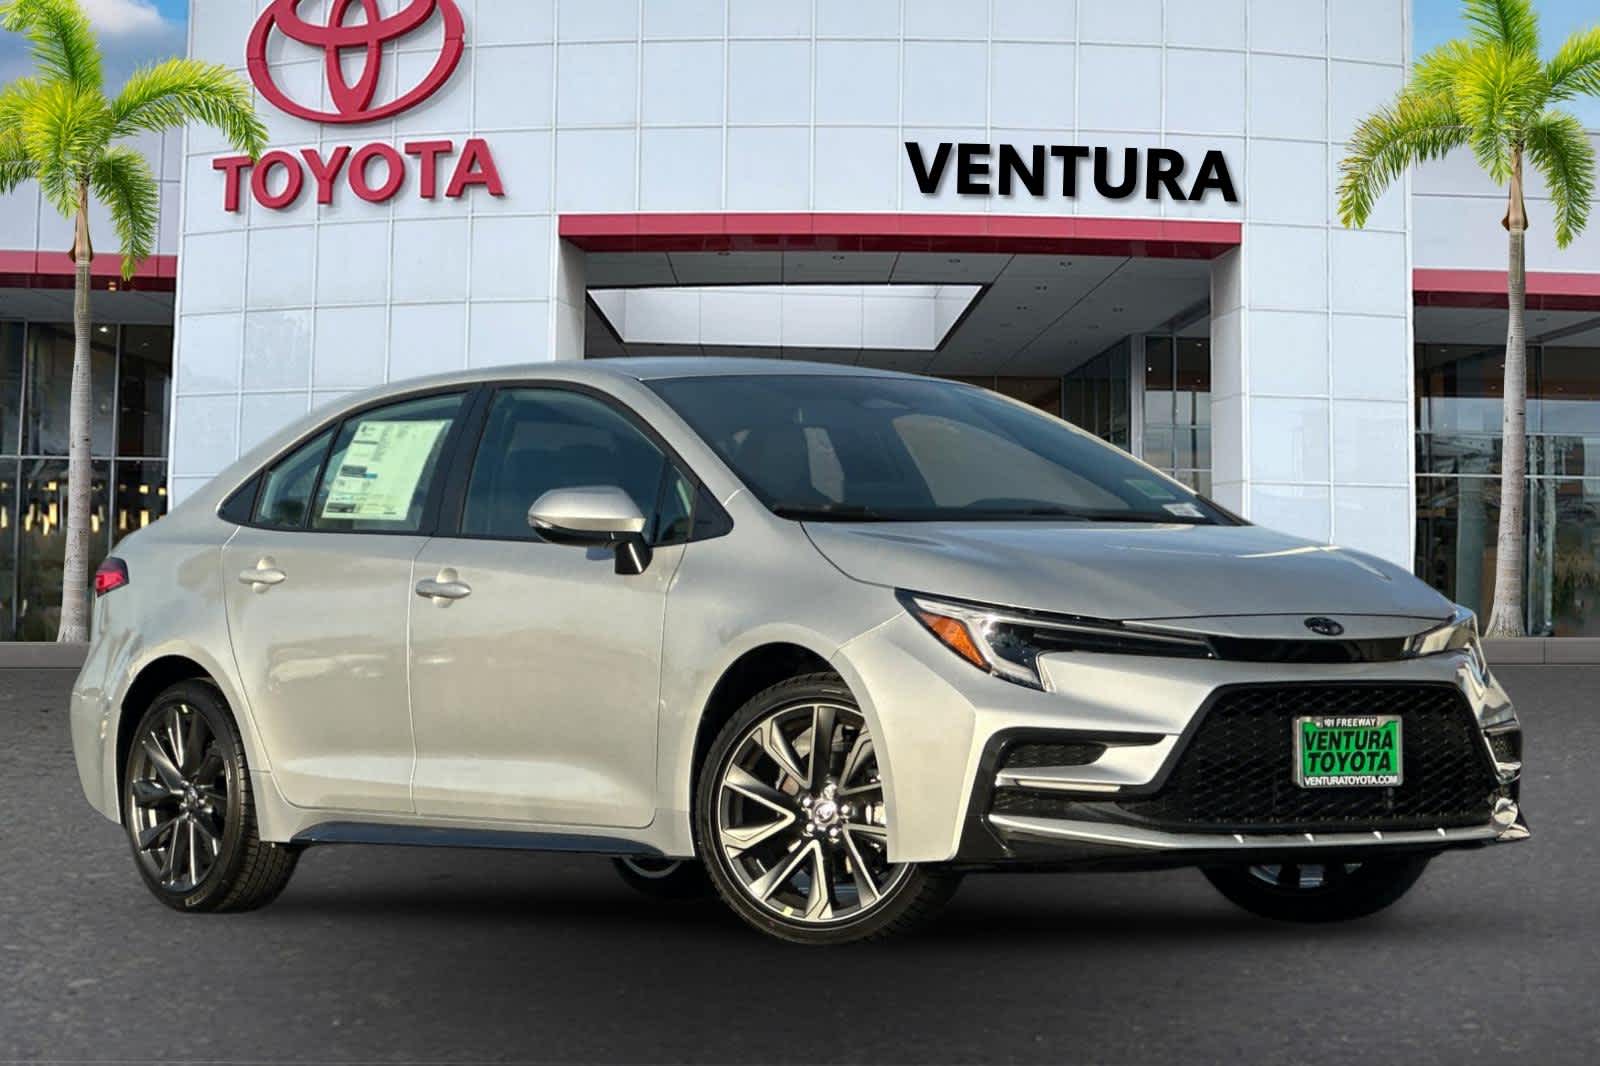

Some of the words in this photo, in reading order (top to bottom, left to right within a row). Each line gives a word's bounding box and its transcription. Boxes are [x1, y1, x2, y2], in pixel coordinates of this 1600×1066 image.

[213, 138, 505, 212] TOYOTA
[905, 142, 1238, 202] VENTURA
[1336, 718, 1376, 727] FREEWAY
[1304, 731, 1393, 750] VENTURA
[1308, 752, 1391, 772] TOYOTA
[1304, 776, 1397, 786] VENTURATOYOTA.COM
